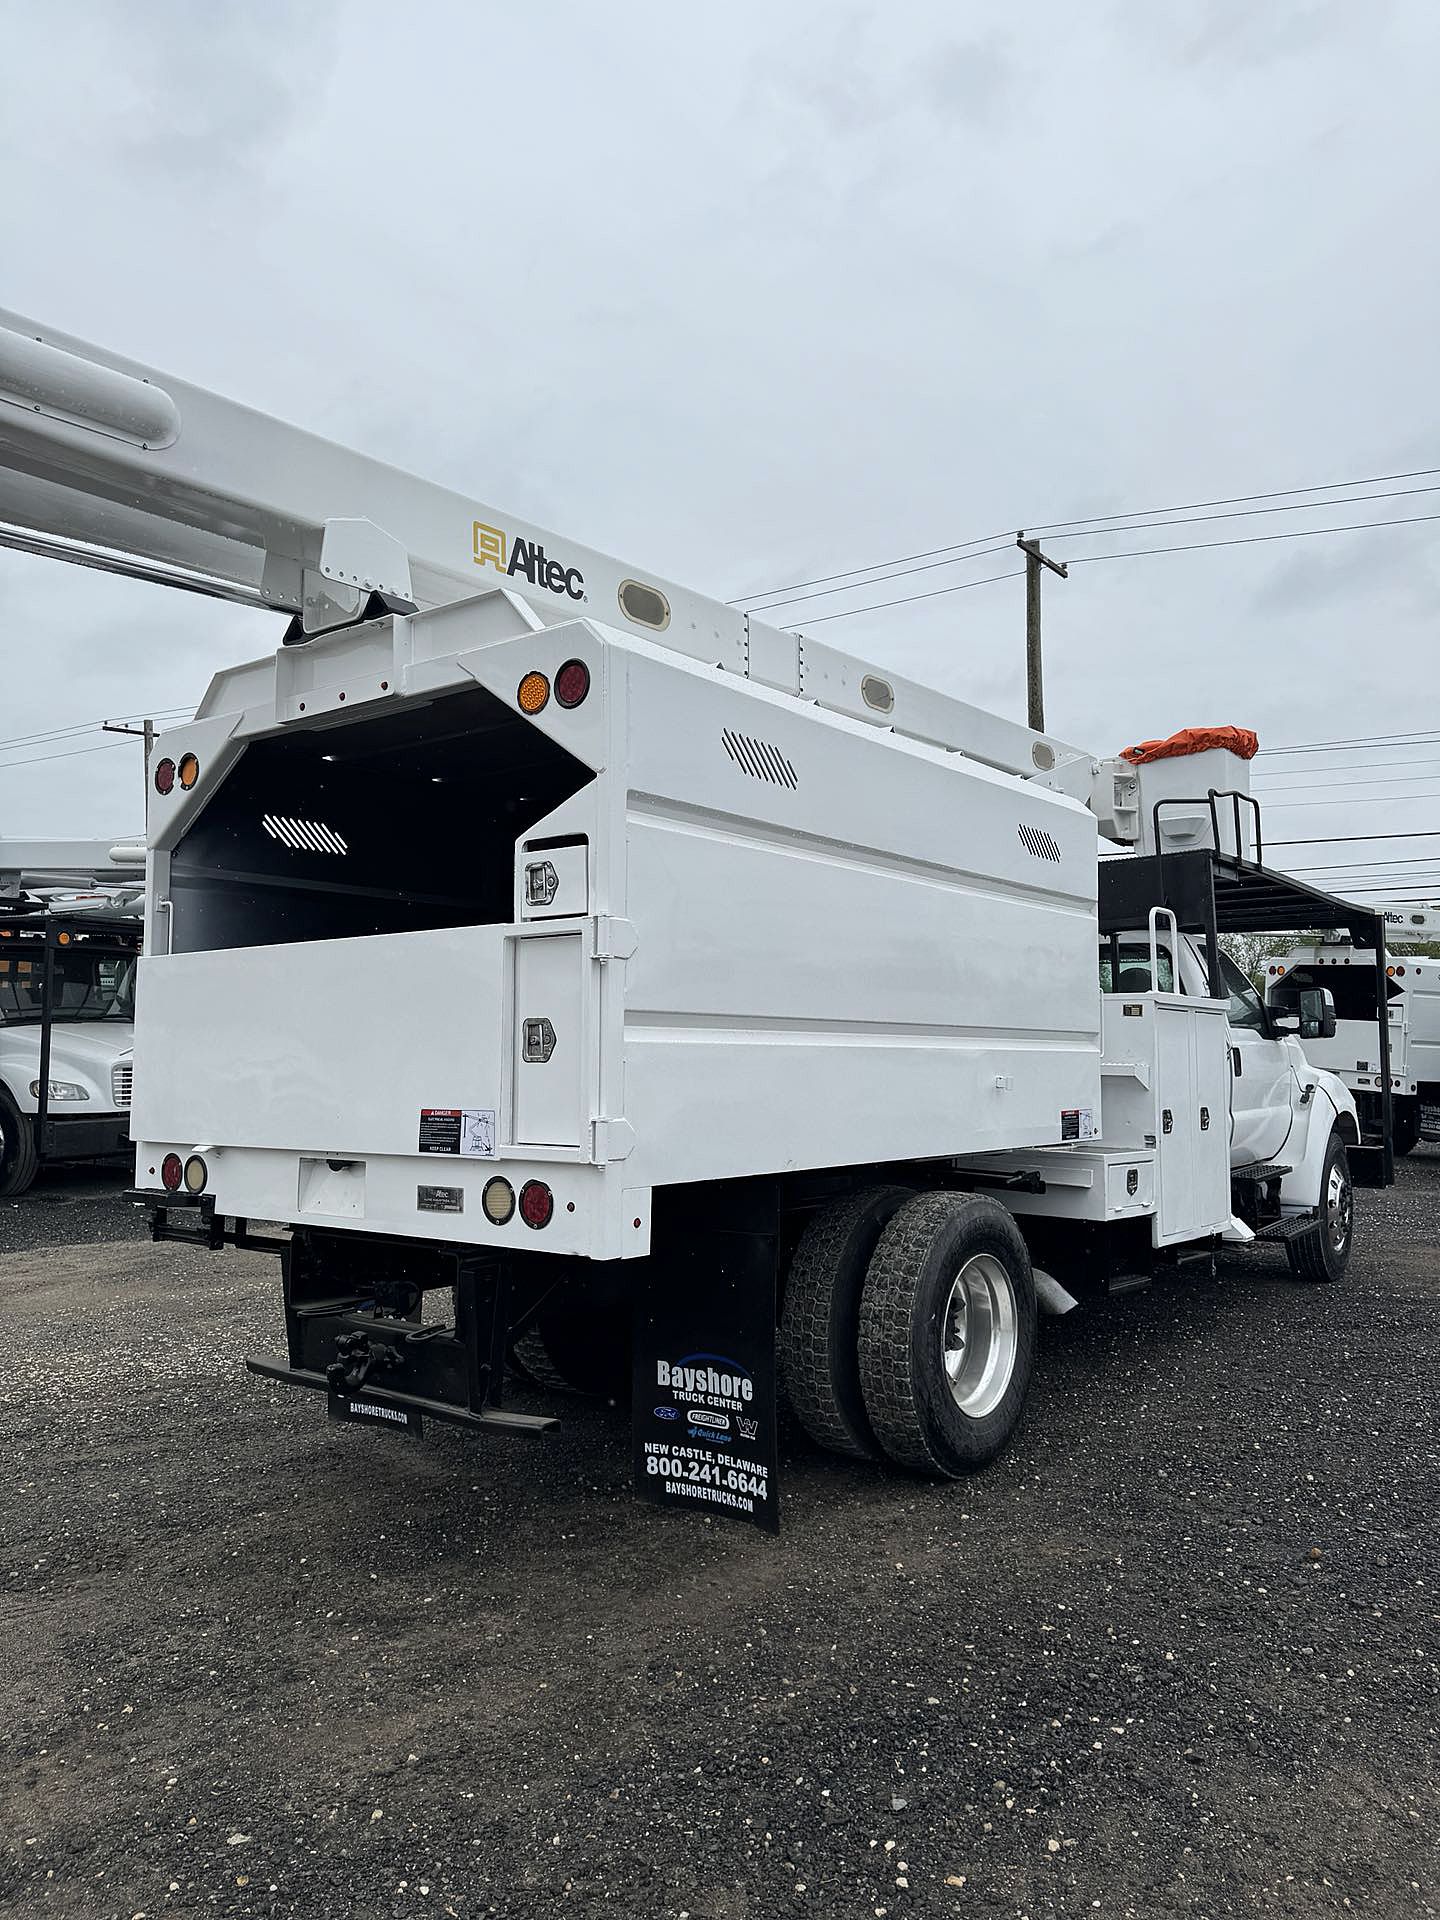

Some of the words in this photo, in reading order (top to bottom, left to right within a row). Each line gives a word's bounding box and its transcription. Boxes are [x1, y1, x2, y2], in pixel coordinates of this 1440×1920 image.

[507, 537, 584, 600] Altec
[657, 1360, 753, 1401] Bayshore
[672, 1390, 705, 1404] TRUCK
[707, 1395, 743, 1412] CENTER
[692, 1413, 726, 1426] FREIGHTLINER
[644, 1443, 669, 1455] NEW
[672, 1446, 715, 1465] CASTLE,
[718, 1453, 768, 1478] DELAWARE
[646, 1456, 768, 1500] 800-241-6644
[665, 1481, 754, 1512] BAYSHORETRUCKS.COM
